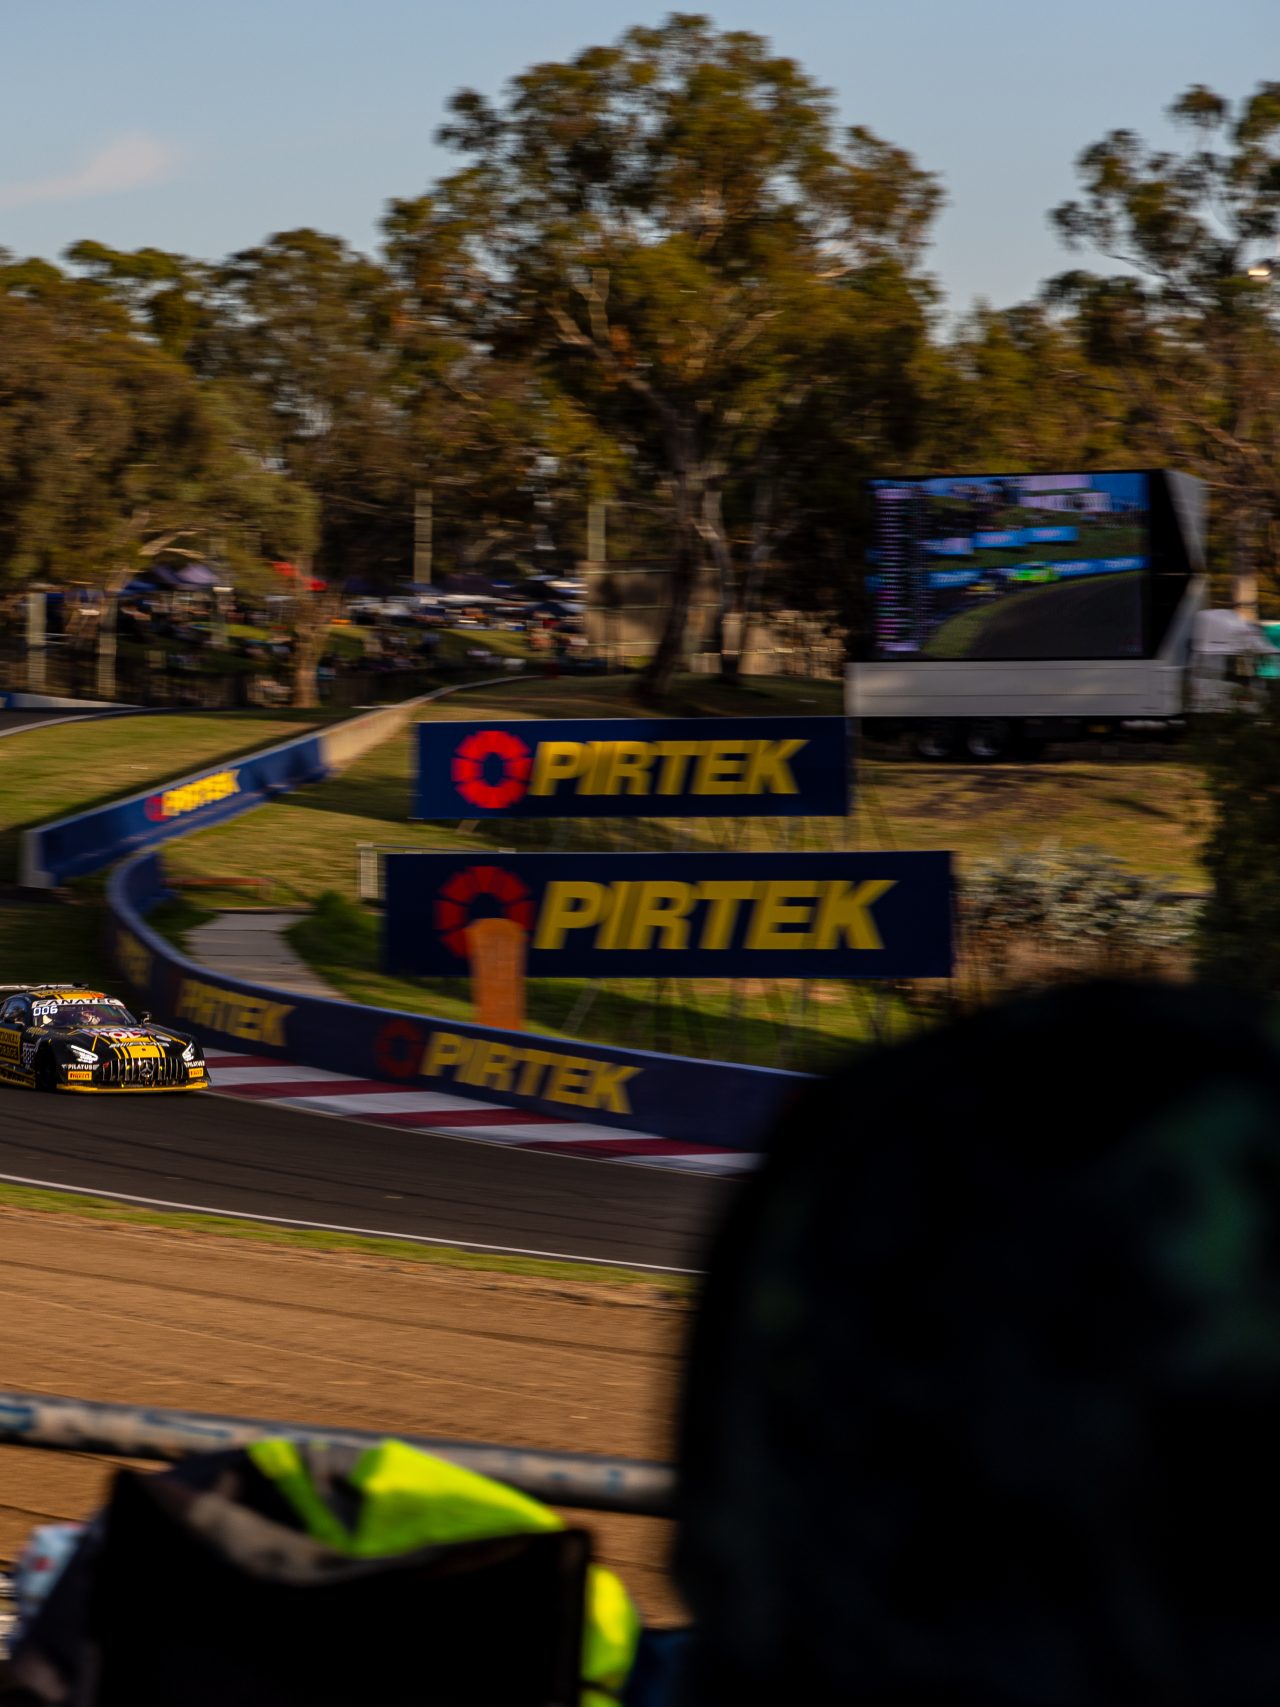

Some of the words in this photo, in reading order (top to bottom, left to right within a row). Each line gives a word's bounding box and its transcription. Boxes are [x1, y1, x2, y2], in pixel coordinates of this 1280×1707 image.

[530, 739, 808, 796] PIRTEK
[532, 880, 897, 950] PIRTEK
[33, 1005, 58, 1016] 006
[35, 997, 117, 1008] FANATEC
[178, 981, 292, 1047] PIRTEK
[422, 1032, 637, 1113] PIRTEK
